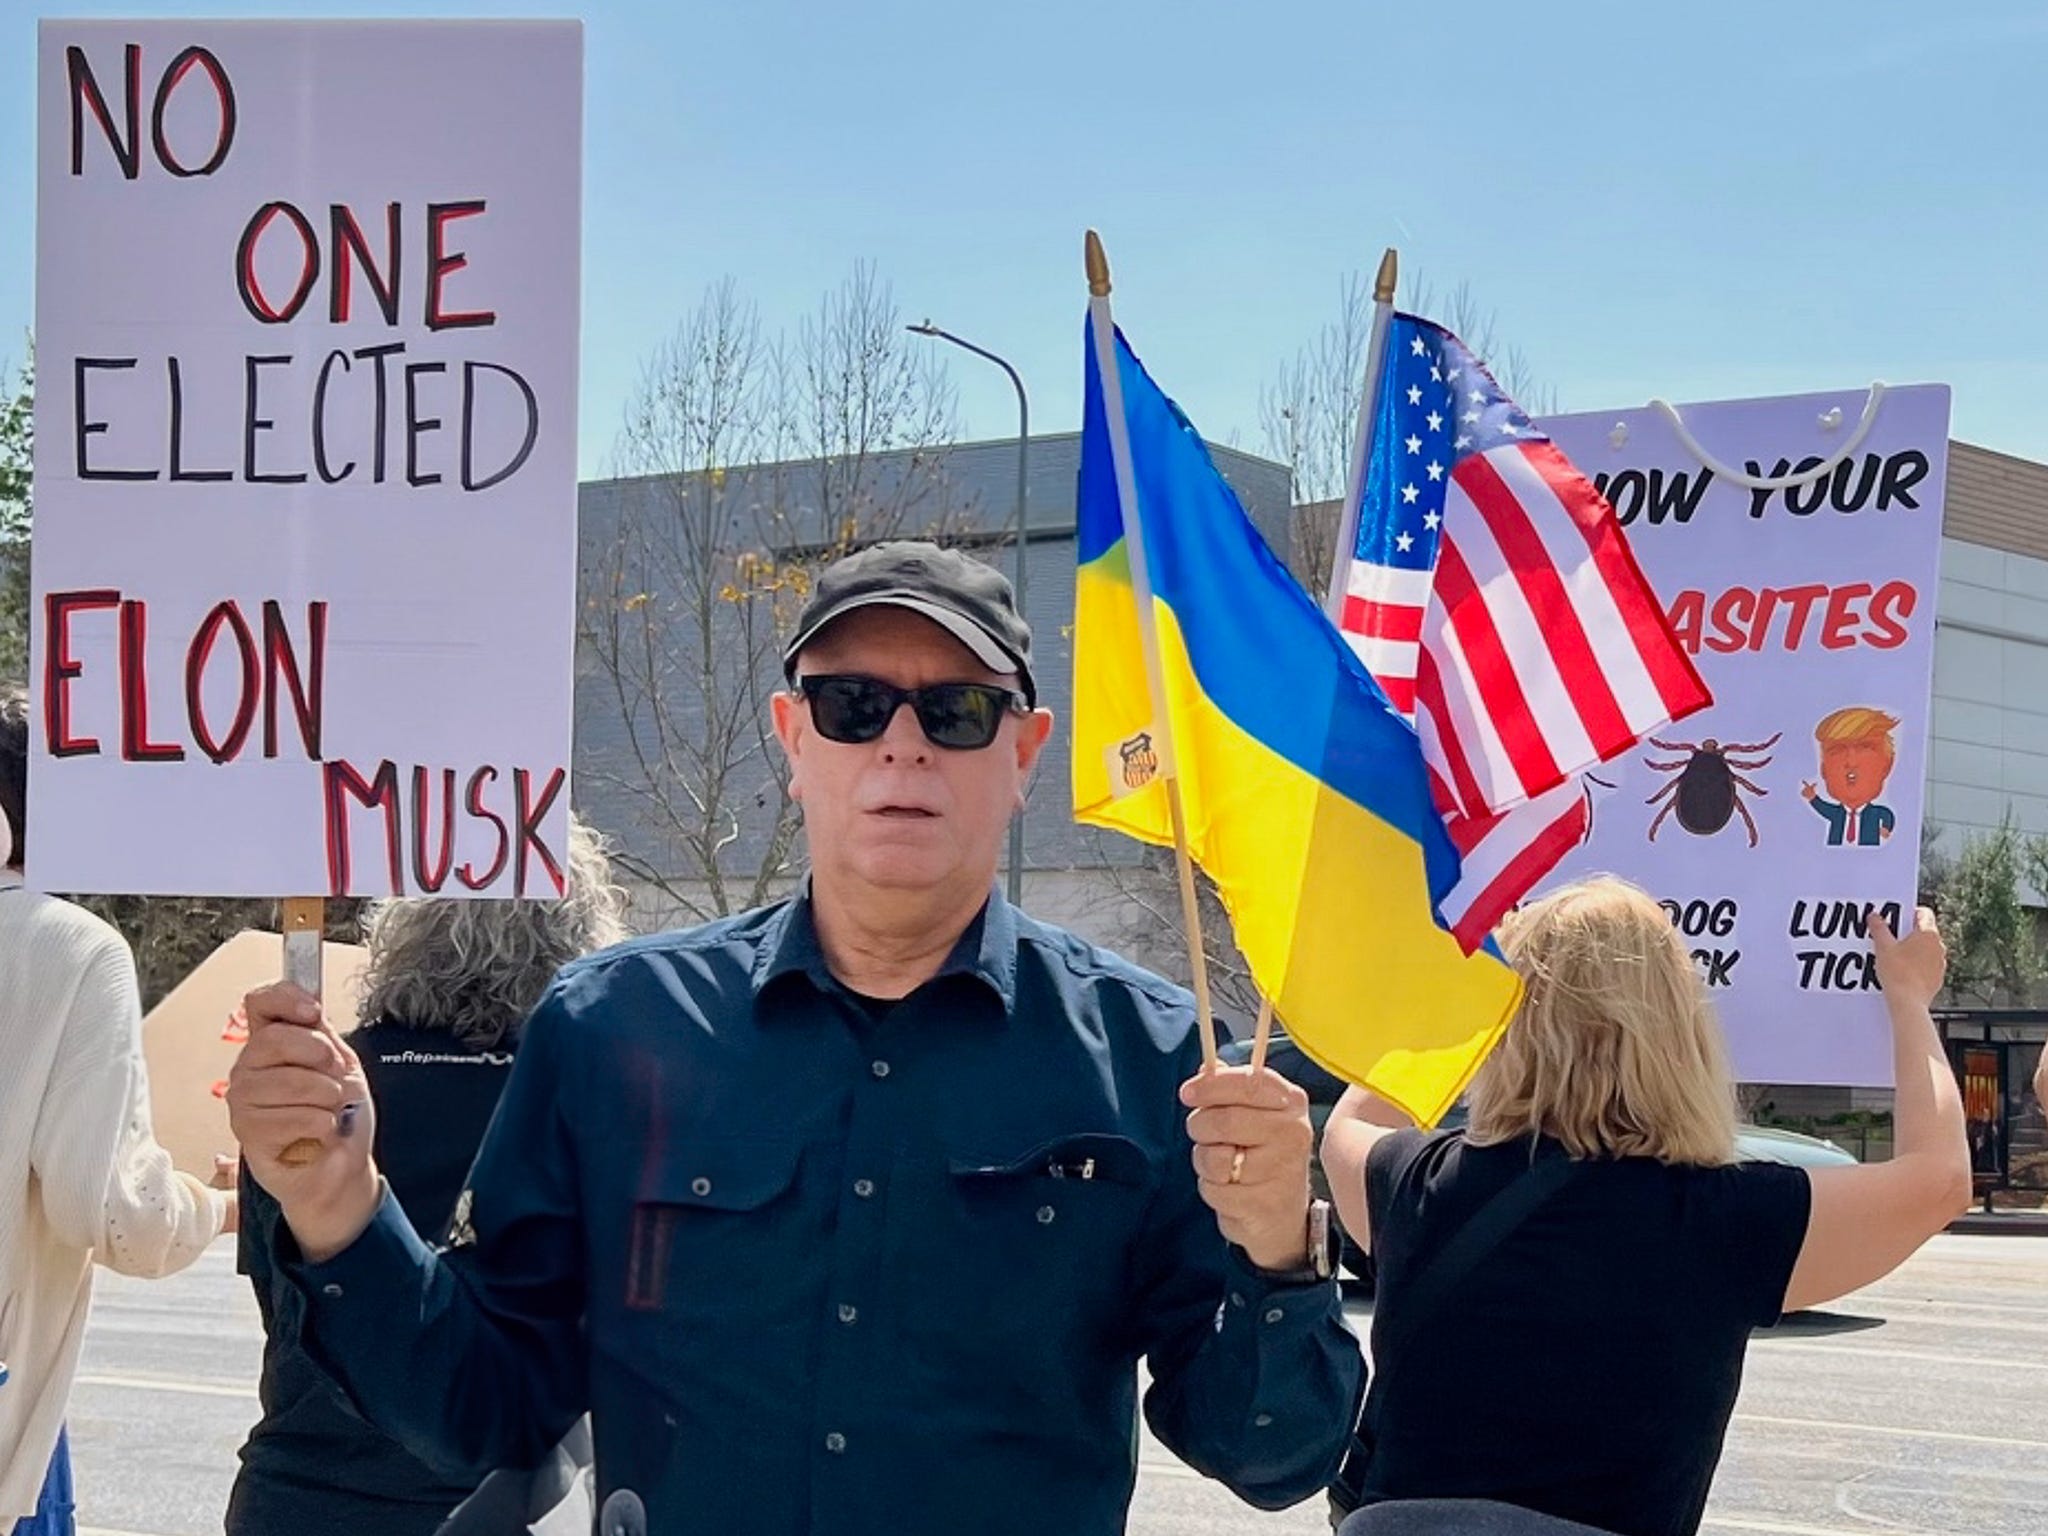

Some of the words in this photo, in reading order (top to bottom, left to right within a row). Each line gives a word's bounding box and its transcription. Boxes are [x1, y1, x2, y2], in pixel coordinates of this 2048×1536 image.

[67, 44, 236, 179] NO
[236, 200, 495, 331] ONE
[75, 342, 538, 490] ELECTED
[1746, 450, 1929, 518] YOUR
[44, 589, 328, 763] ELON
[1667, 581, 1917, 654] ASITES
[323, 759, 566, 898] MUSK
[1790, 900, 1901, 940] LUNA
[1796, 952, 1882, 991] TICK
